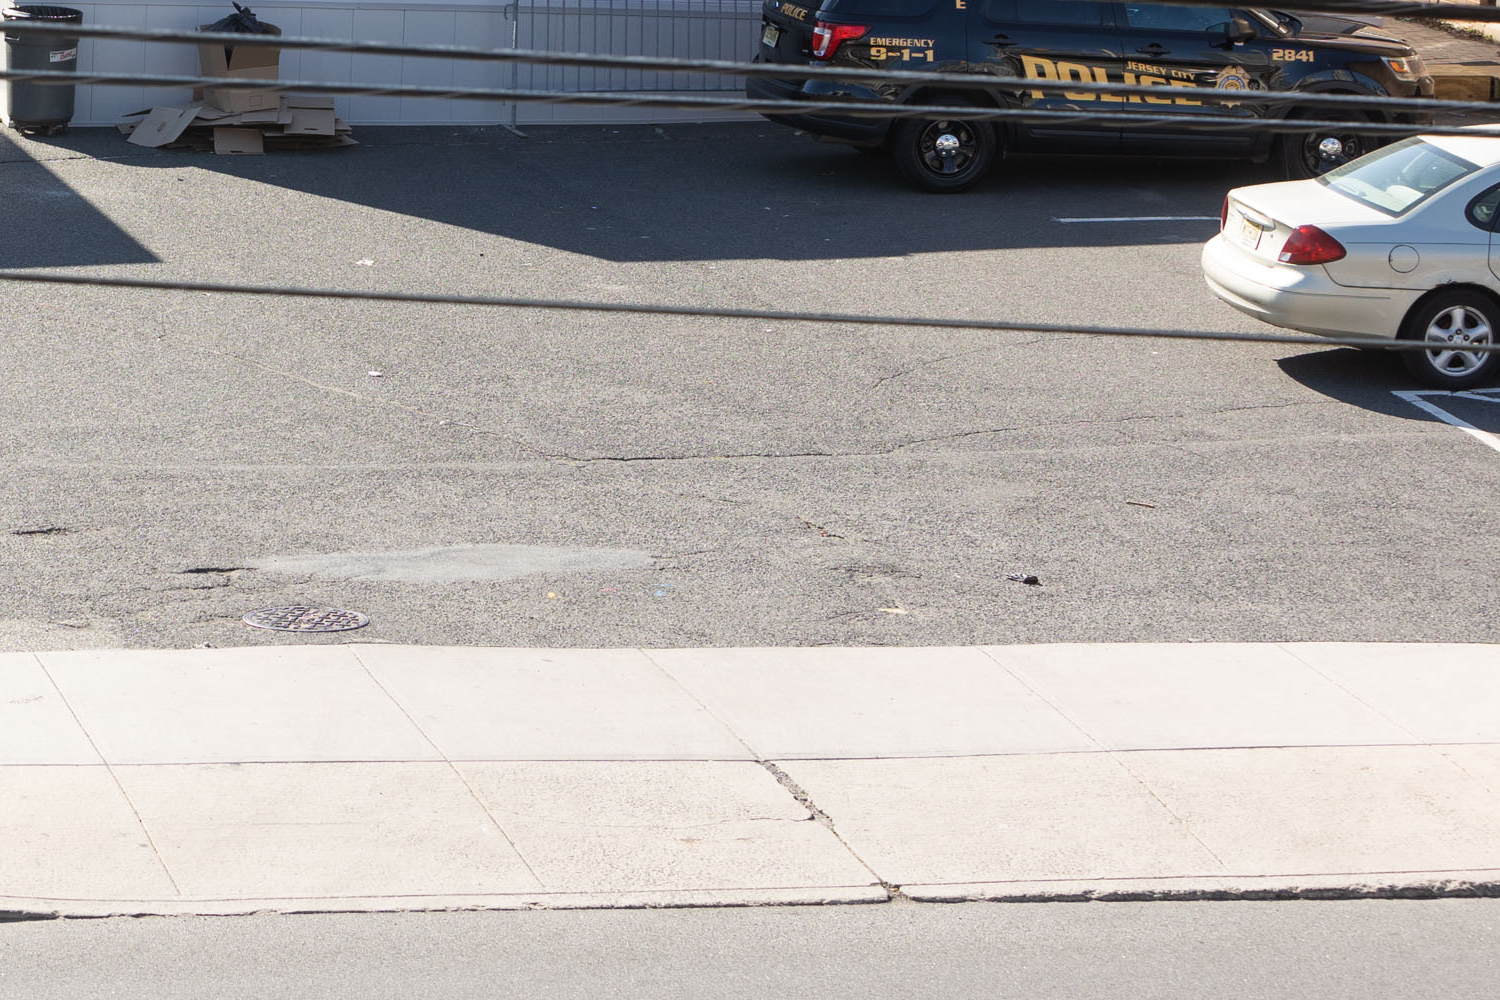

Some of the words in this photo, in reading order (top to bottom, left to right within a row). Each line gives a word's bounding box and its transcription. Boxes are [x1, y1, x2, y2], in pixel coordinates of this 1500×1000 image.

[780, 2, 809, 22] POLICE
[869, 37, 935, 48] EMERGENCY
[869, 47, 935, 63] 9-1-1
[1272, 48, 1315, 63] 2841
[1125, 60, 1167, 76] JERSEY
[1170, 69, 1196, 81] CITY
